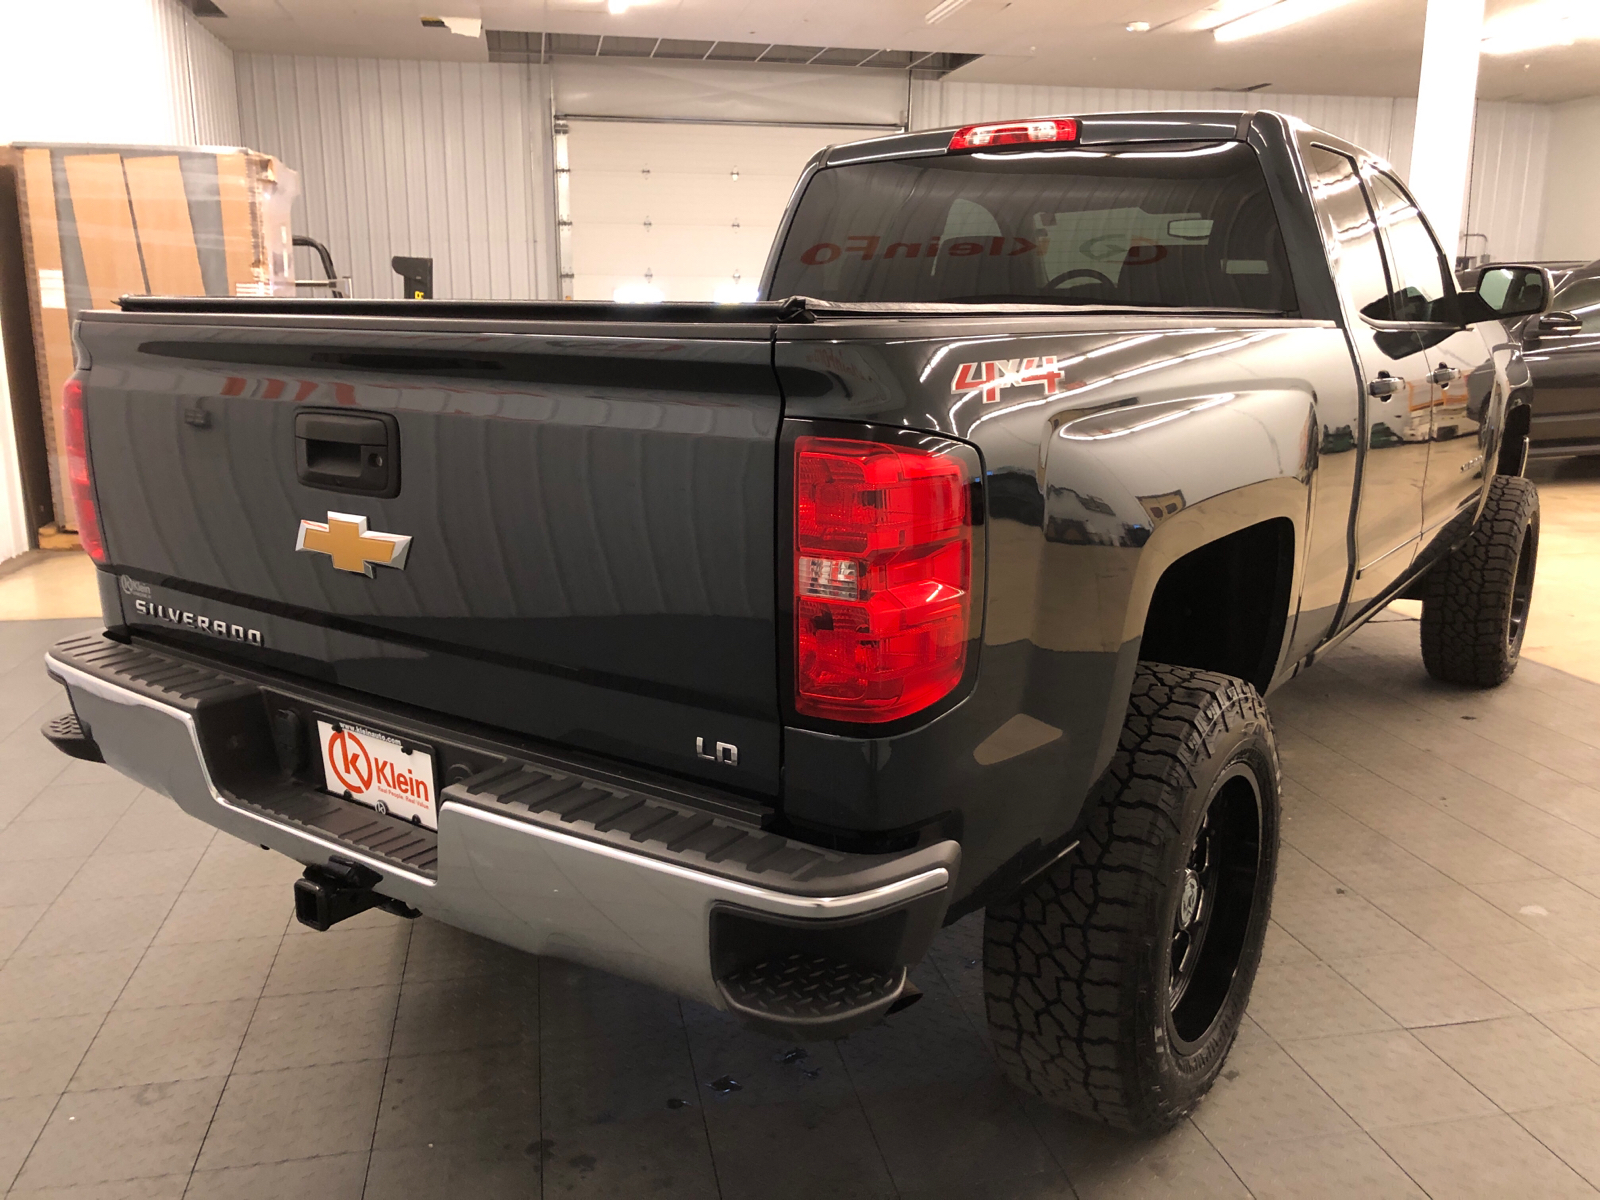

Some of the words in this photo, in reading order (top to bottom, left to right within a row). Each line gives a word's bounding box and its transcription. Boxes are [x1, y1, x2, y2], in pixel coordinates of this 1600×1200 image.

[135, 599, 262, 647] SILVERADO
[339, 722, 401, 746] www.kleinauto.com
[696, 736, 738, 766] LD
[374, 757, 429, 802] Klein
